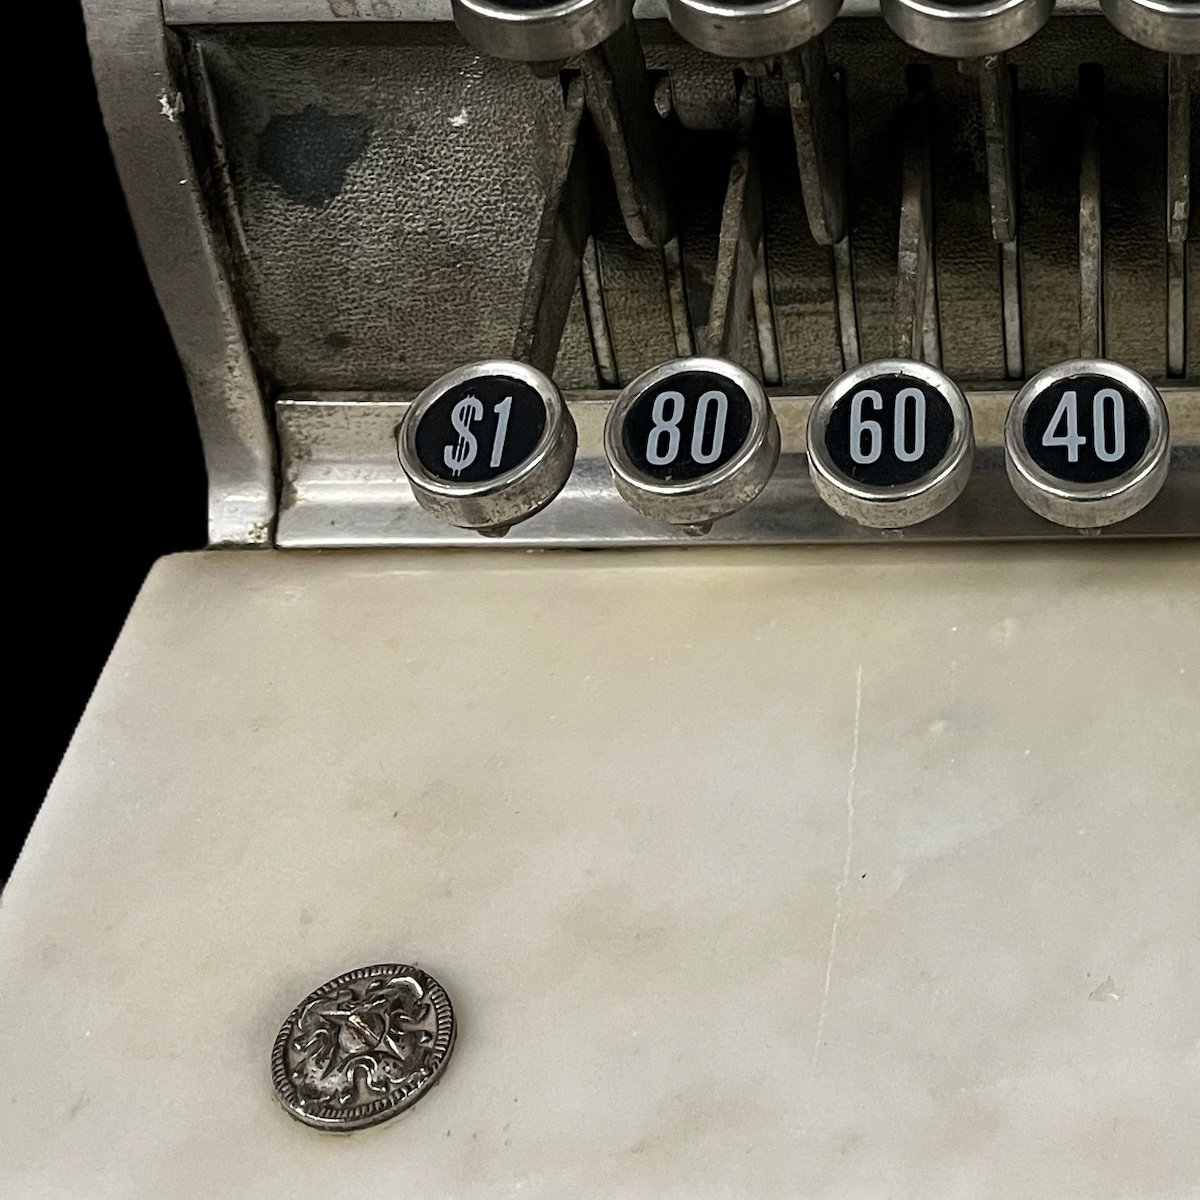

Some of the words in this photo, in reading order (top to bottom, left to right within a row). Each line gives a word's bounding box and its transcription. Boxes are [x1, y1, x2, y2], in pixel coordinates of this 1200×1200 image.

[443, 392, 514, 476] $1
[645, 390, 729, 466] 80
[849, 386, 926, 465] 60
[1041, 387, 1128, 463] 40
